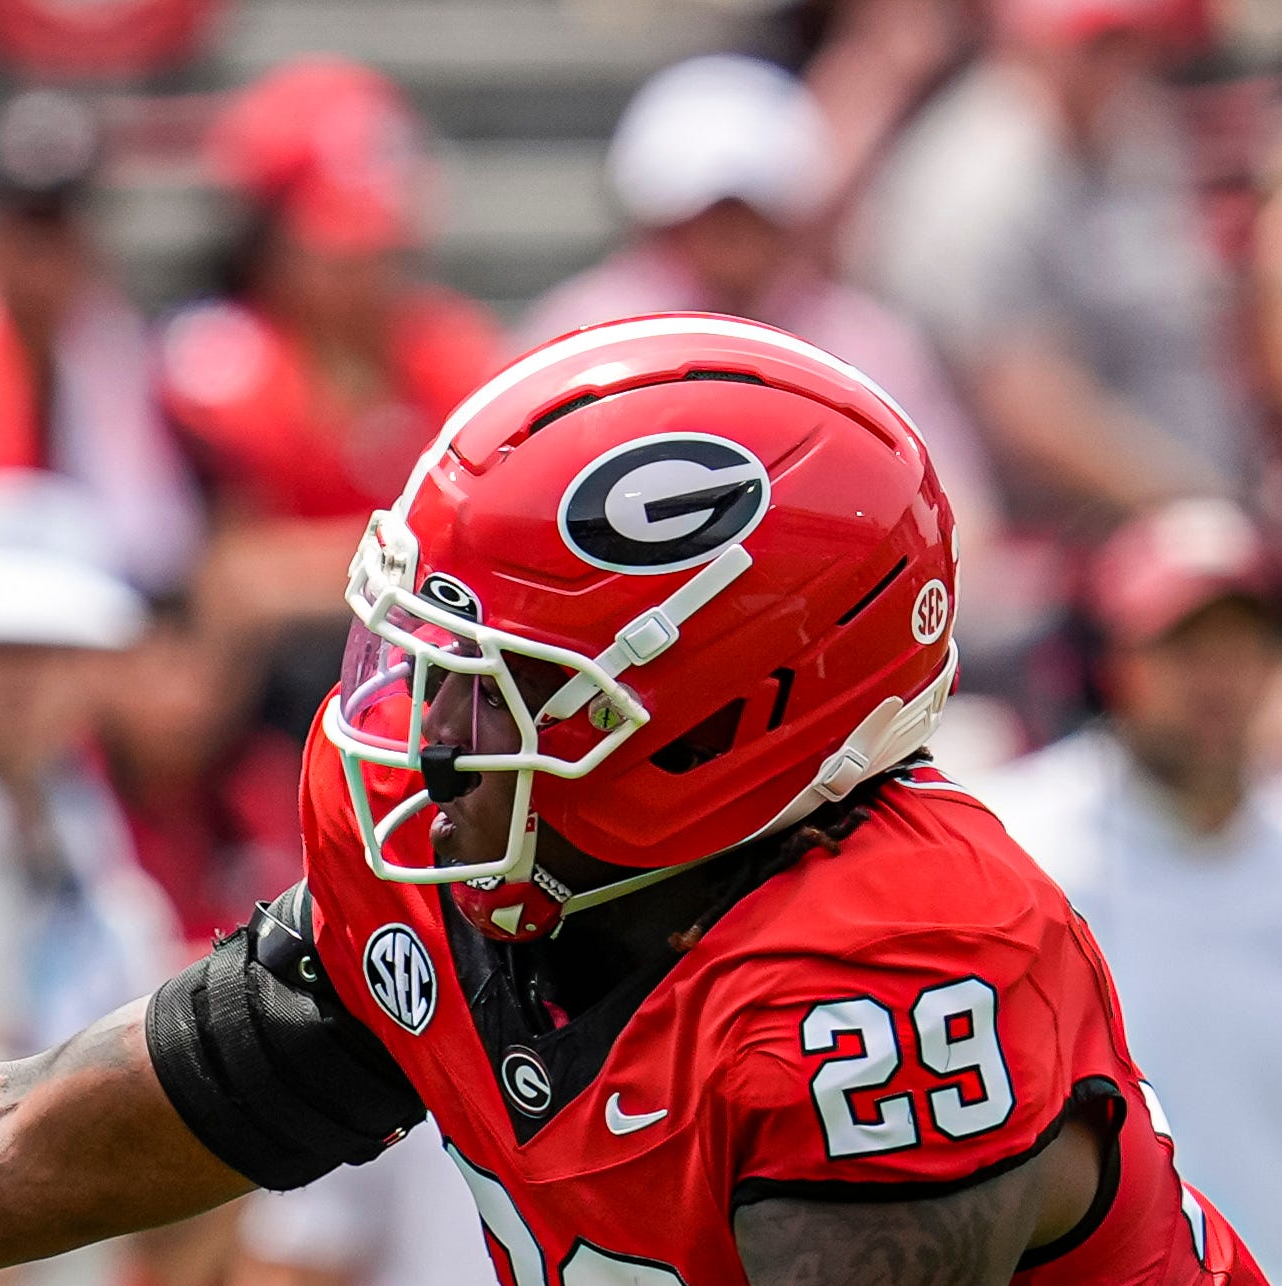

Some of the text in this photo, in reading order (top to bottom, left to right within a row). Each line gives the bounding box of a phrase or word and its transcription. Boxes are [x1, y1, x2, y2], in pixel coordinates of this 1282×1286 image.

[566, 439, 764, 567] G
[917, 587, 944, 636] SEC
[370, 931, 430, 1027] SEC
[800, 973, 1015, 1161] 29
